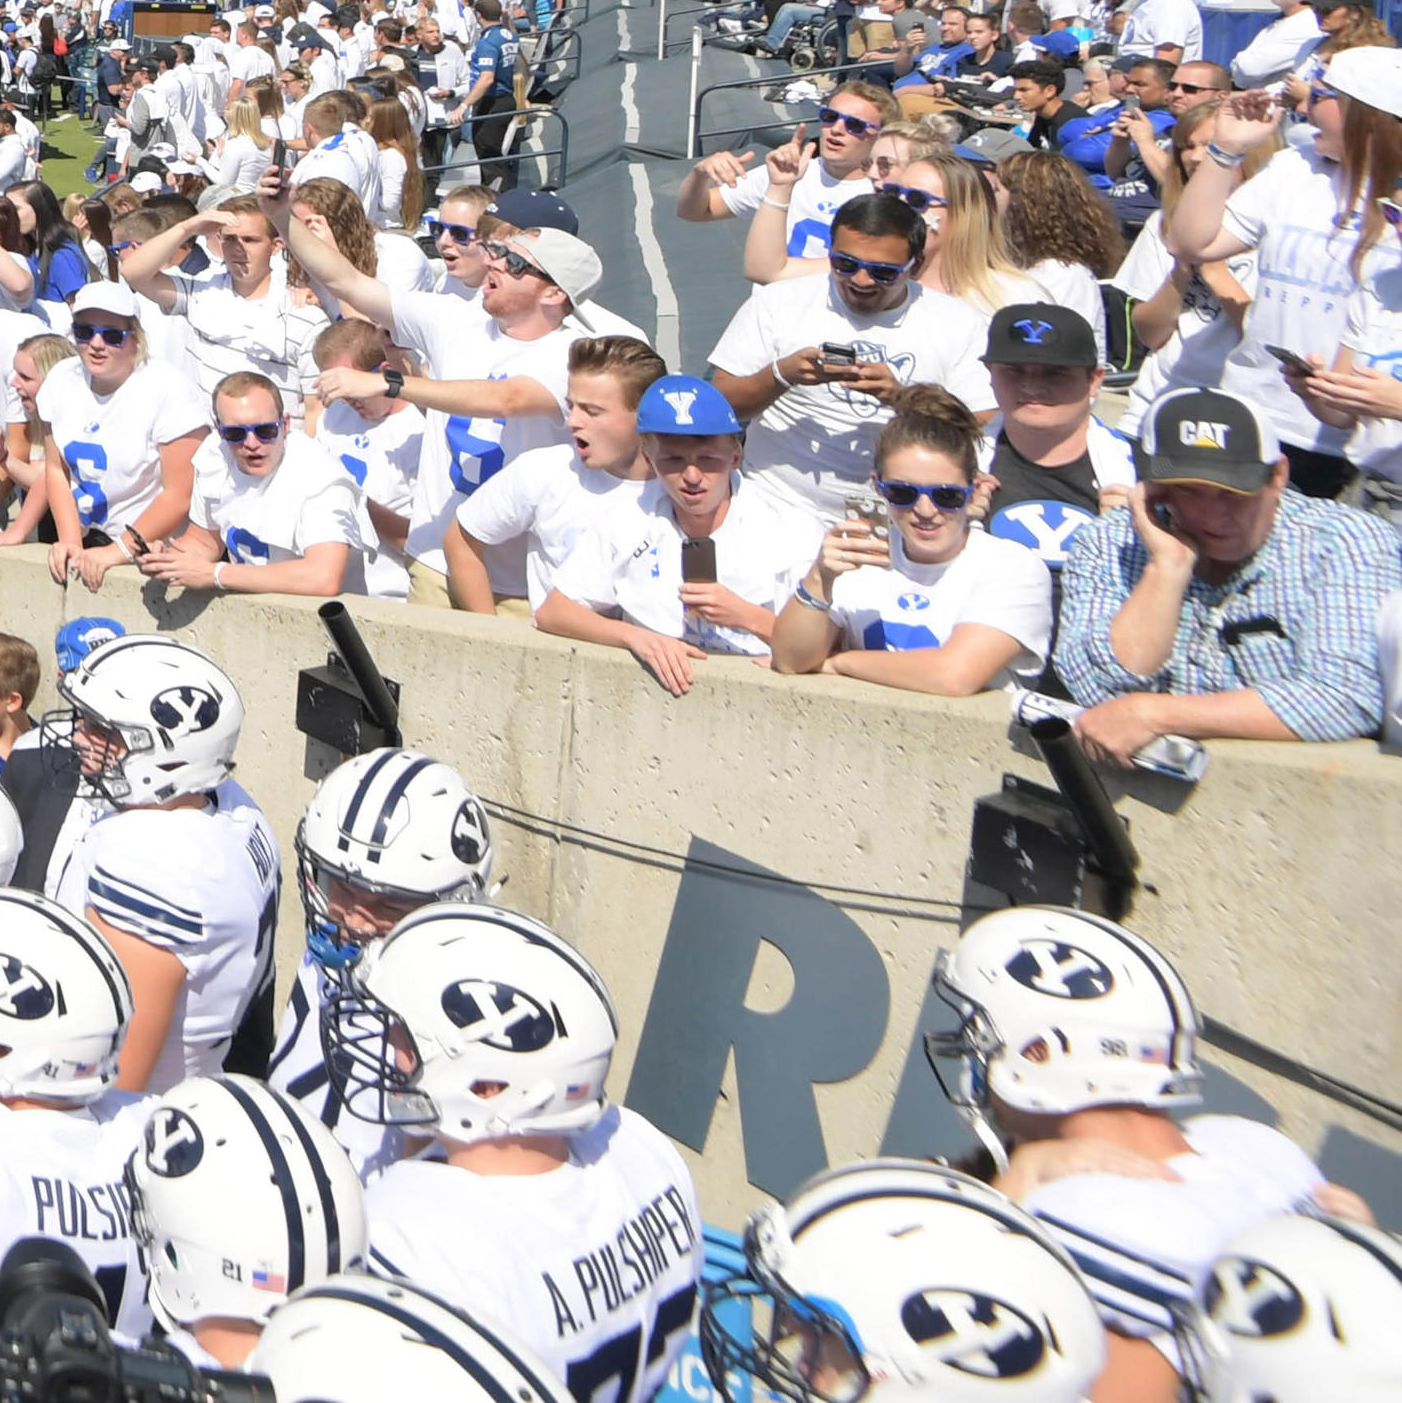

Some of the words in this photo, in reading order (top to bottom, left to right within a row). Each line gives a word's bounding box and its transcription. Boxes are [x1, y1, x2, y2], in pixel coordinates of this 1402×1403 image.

[664, 393, 697, 425] Y
[1179, 420, 1231, 448] CAT
[64, 441, 108, 526] 6
[541, 1270, 585, 1339] A.
